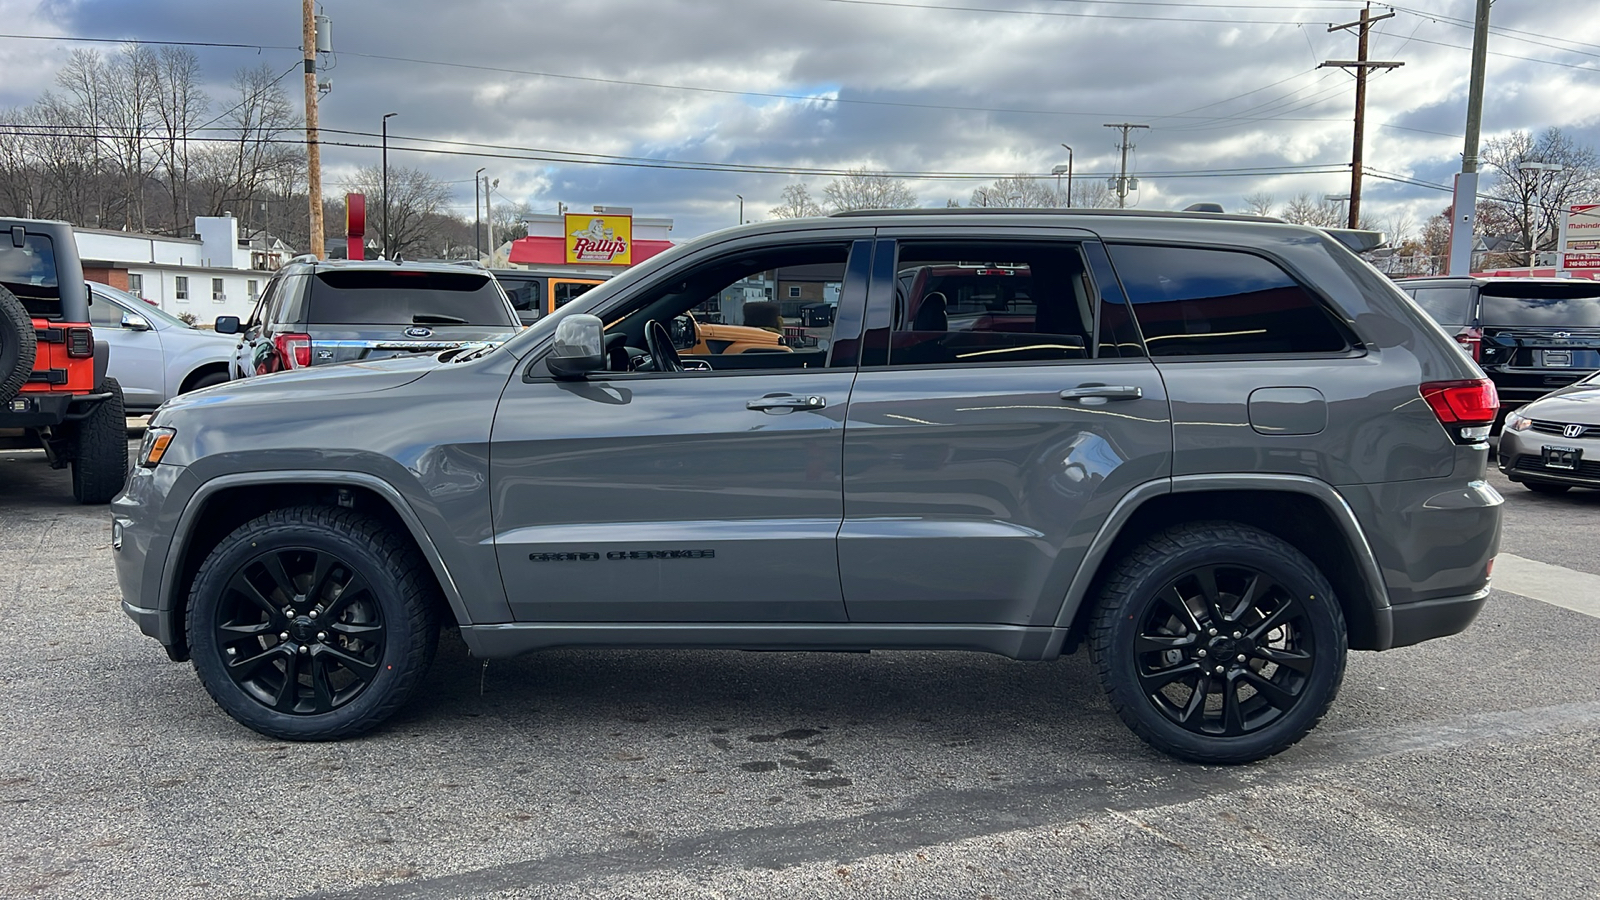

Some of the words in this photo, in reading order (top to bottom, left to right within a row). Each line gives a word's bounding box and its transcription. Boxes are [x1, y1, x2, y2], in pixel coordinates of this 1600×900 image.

[573, 236, 626, 260] Rally's
[529, 552, 599, 562] GRAND
[606, 549, 715, 560] CHEROKEE
